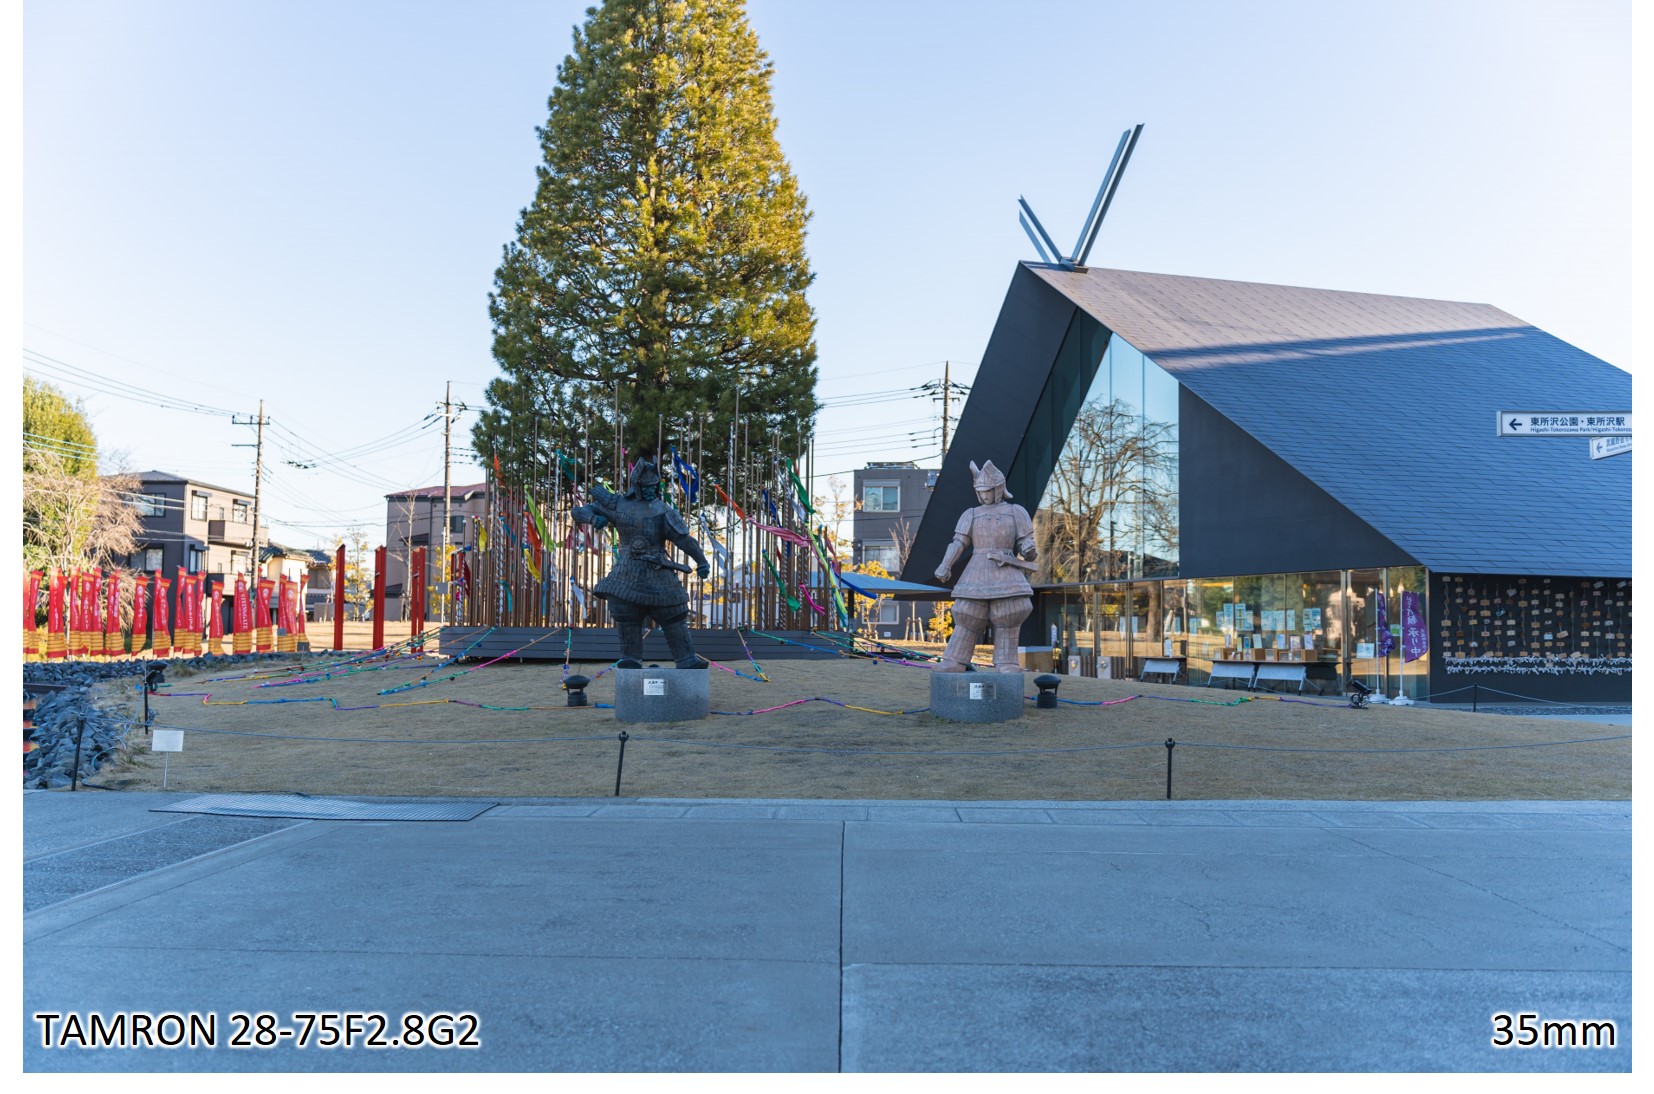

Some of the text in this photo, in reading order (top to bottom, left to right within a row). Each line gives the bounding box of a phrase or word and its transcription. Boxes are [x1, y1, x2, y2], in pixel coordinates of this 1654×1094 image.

[1530, 416, 1625, 427] 東所沢公園・東所沢駅
